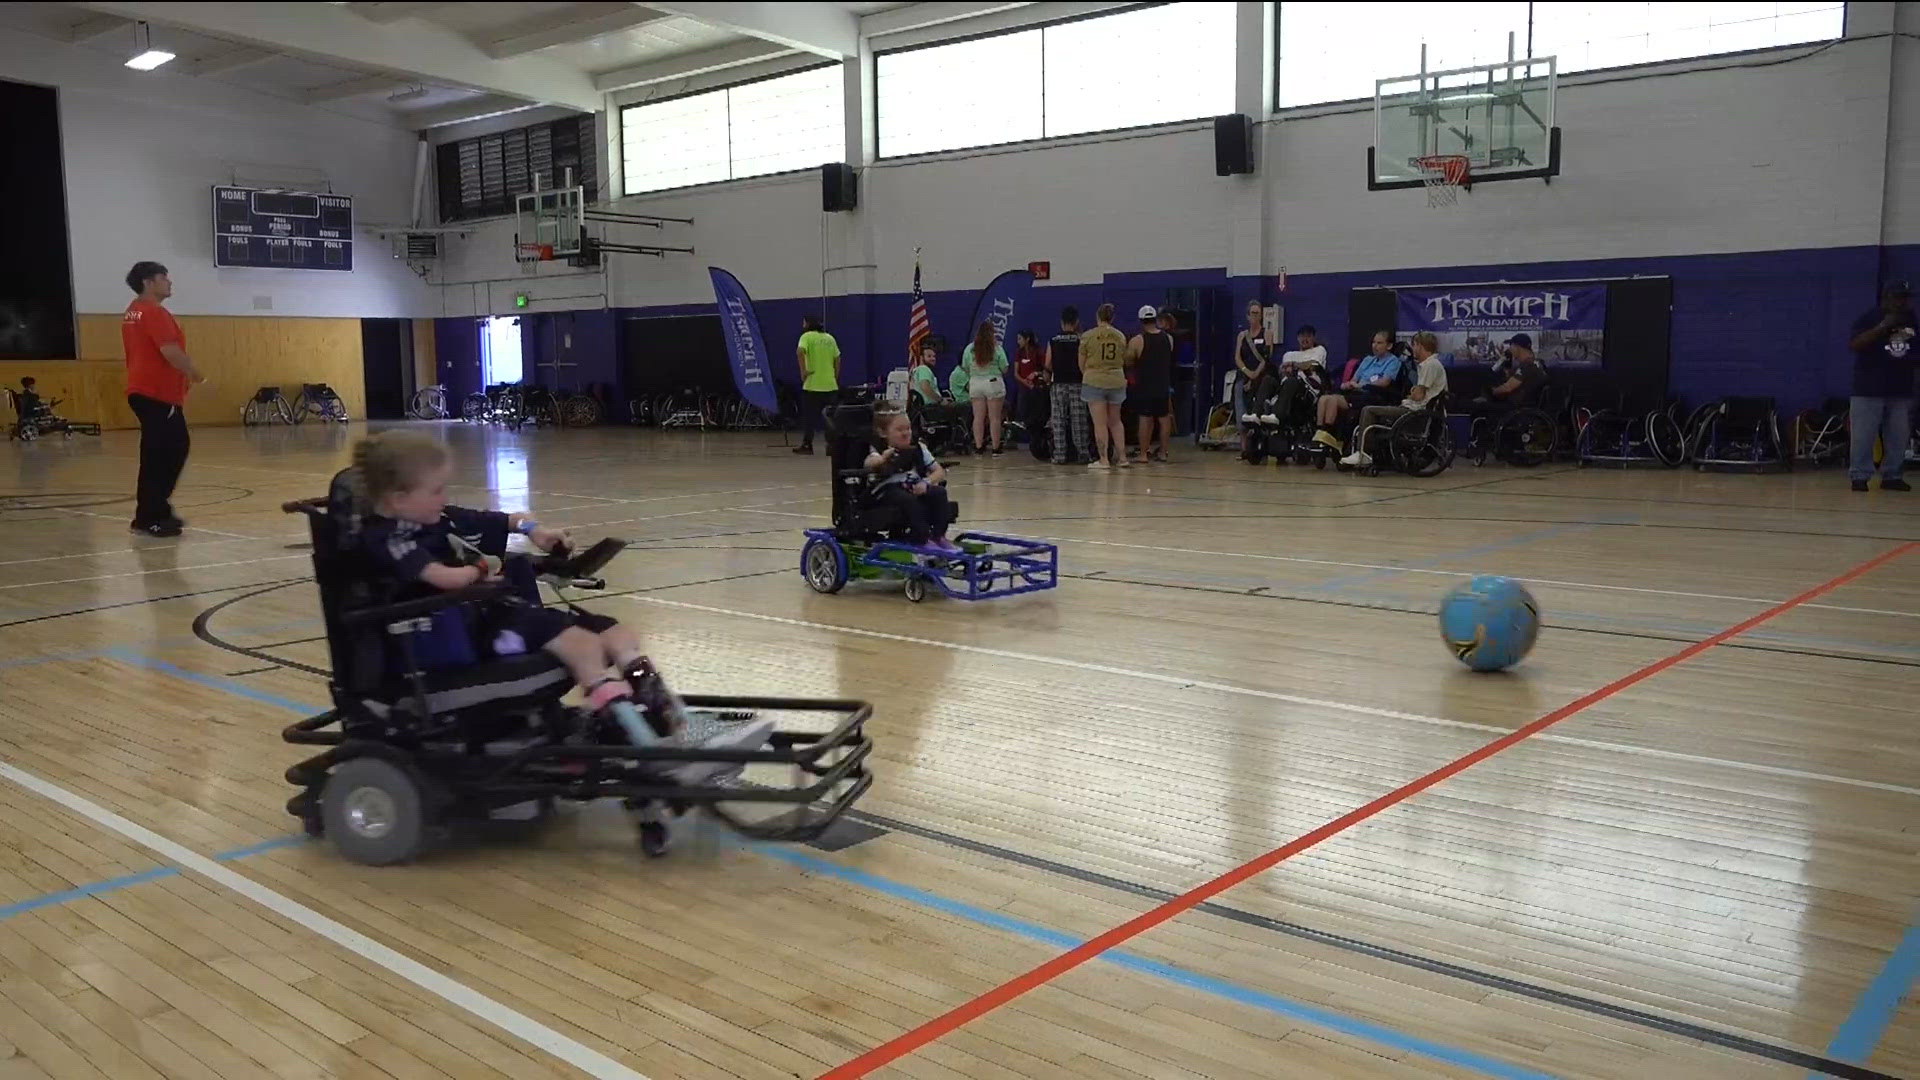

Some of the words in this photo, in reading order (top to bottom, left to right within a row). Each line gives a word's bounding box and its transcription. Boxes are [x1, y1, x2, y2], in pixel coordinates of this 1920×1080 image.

[221, 190, 247, 201] HOME
[320, 198, 351, 207] VISITOR
[231, 225, 253, 233] BONUS
[269, 222, 292, 231] PERIOD
[319, 230, 339, 238] BONUS
[228, 236, 249, 245] FOULS
[266, 239, 290, 247] PLAYER
[293, 240, 313, 248] FOULS
[324, 241, 343, 249] FOULS
[1426, 291, 1572, 322] TRIUMPH
[1453, 318, 1541, 328] FOUNDATION
[1101, 343, 1117, 360] 13
